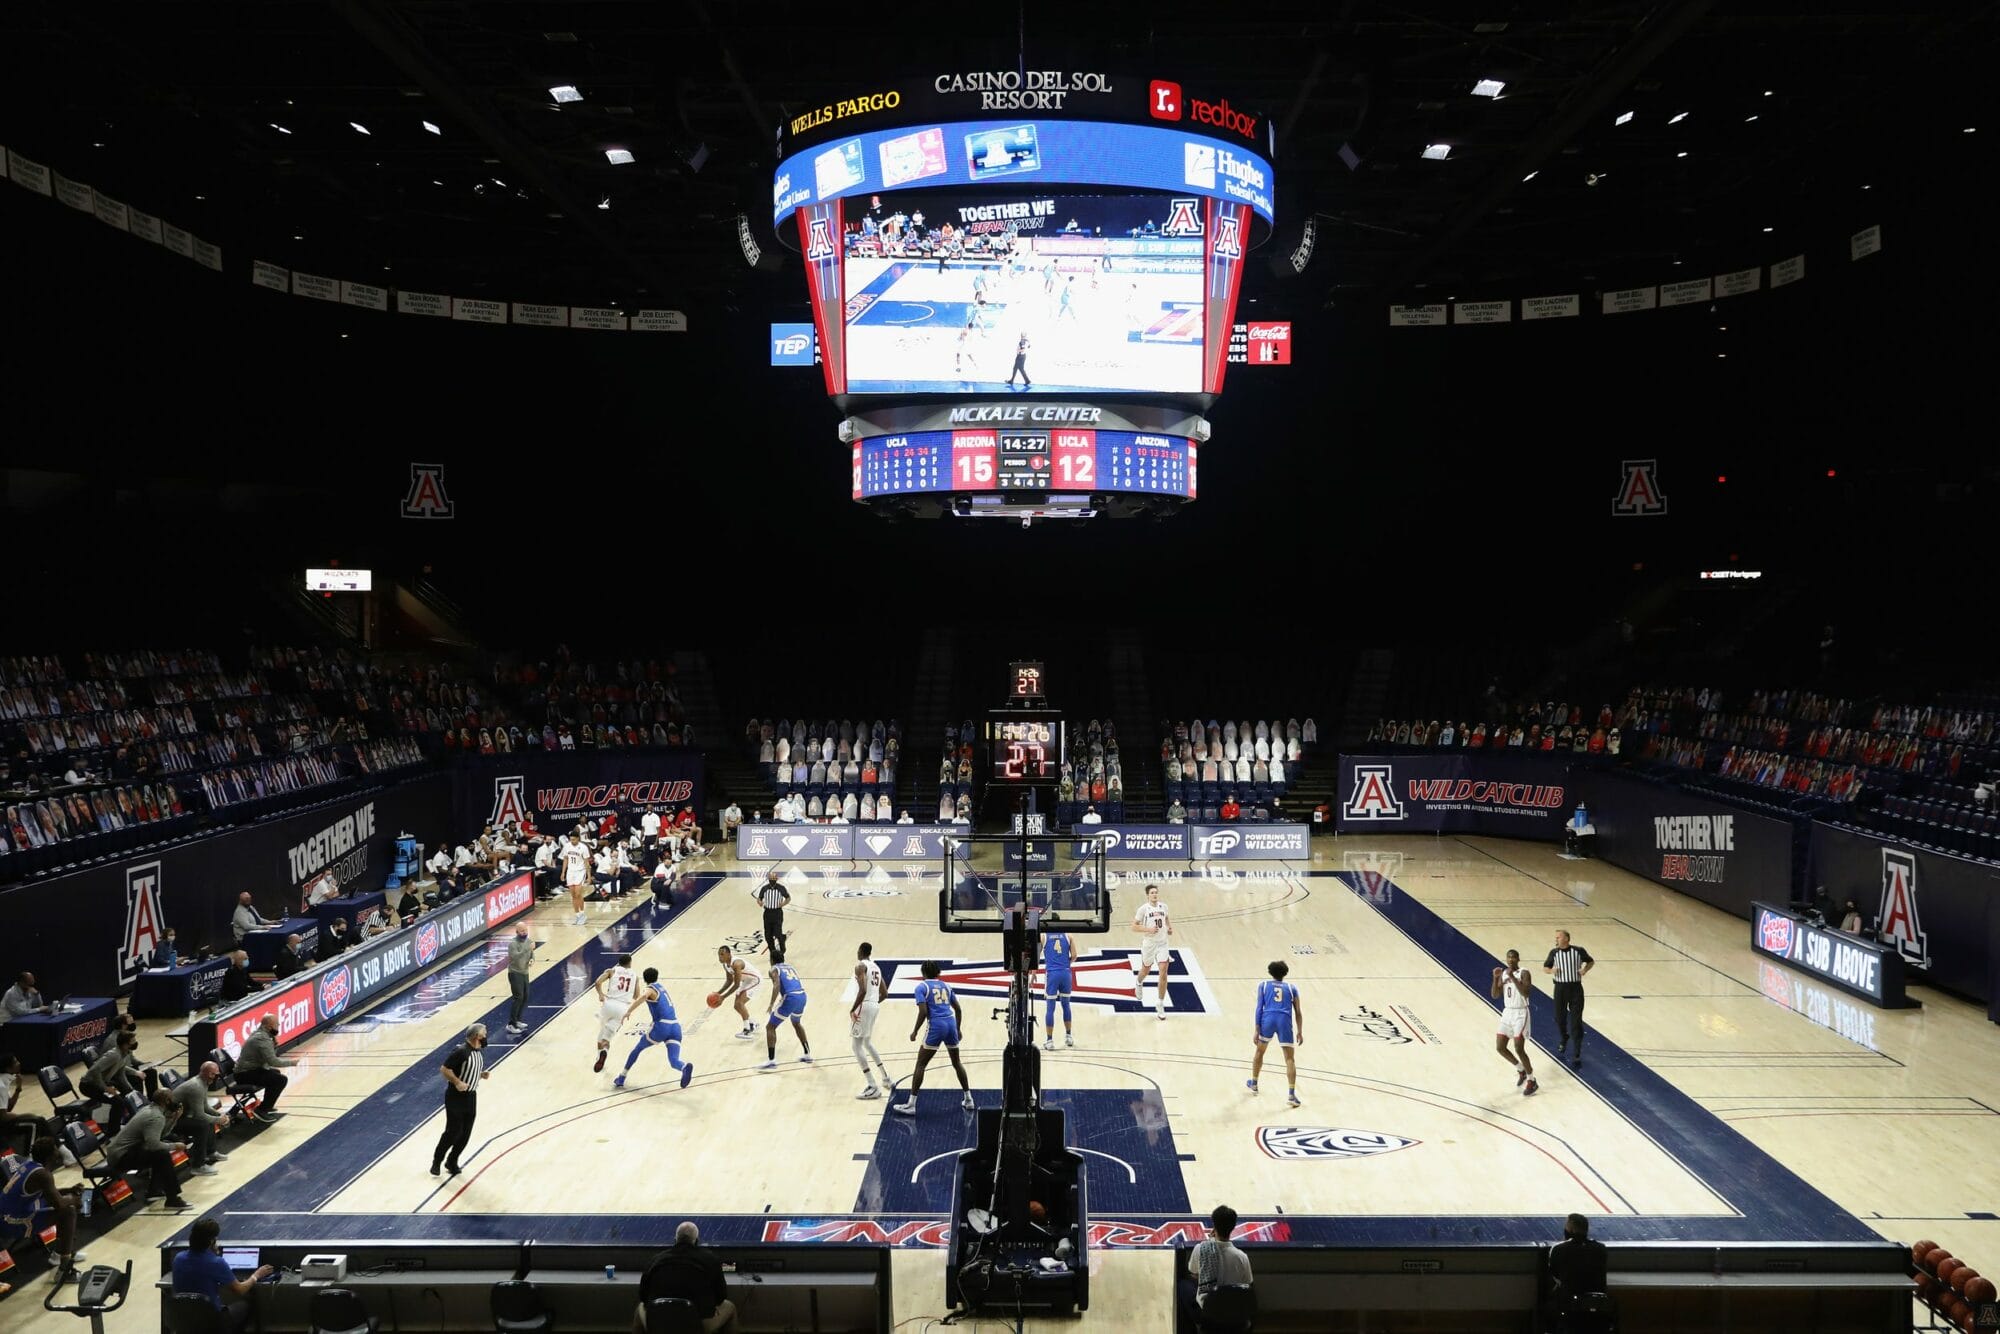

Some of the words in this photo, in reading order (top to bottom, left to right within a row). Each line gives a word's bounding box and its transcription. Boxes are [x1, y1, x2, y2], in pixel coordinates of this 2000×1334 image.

[935, 71, 1020, 93] CASINO
[1025, 71, 1069, 91] DEL
[1072, 72, 1113, 94] SOL
[982, 91, 1066, 111] RESORT
[791, 105, 833, 135] WELLS
[836, 91, 900, 120] FARGO
[1192, 98, 1256, 139] redbox
[1217, 150, 1264, 189] Hughes
[959, 202, 1032, 223] TOGETHER
[1033, 200, 1056, 215] WE
[775, 335, 809, 355] TEP
[949, 407, 1027, 422] MCKALE
[1030, 407, 1102, 422] CENTER
[886, 437, 908, 448] UCLA
[954, 436, 995, 448] ARIZONA
[1004, 438, 1046, 450] 14:27
[1058, 436, 1089, 448] UCLA
[1135, 436, 1170, 448] ARIZONA
[906, 458, 912, 467] 0
[920, 457, 926, 466] 0
[958, 455, 992, 482] 15
[1059, 455, 1093, 482] 12
[1124, 456, 1131, 466] 0
[906, 469, 912, 478] 0
[920, 468, 926, 477] 0
[1001, 479, 1008, 487] 3
[1013, 478, 1021, 487] 4
[1026, 478, 1034, 487] 4
[1038, 479, 1045, 487] 0
[1124, 478, 1131, 487] 0
[1139, 468, 1145, 477] 0
[401, 462, 454, 519] A
[906, 480, 912, 489] 0
[920, 479, 926, 488] 0
[1612, 459, 1667, 516] A
[1018, 678, 1037, 694] 27
[1006, 745, 1045, 777] 27
[1343, 765, 1403, 820] A
[1199, 832, 1240, 854] TEP
[1244, 840, 1303, 850] WILDCATS
[1654, 815, 1712, 850] TOGETHER
[1713, 815, 1735, 851] WE
[288, 814, 355, 885] TOGETHER
[355, 802, 375, 842] WE
[1125, 840, 1183, 850] WILDCATS
[1874, 847, 1927, 969] A
[440, 923, 446, 945] A
[447, 917, 462, 940] SUB
[463, 903, 485, 930] ABOVE
[1154, 918, 1163, 929] 10
[1054, 938, 1062, 954] 4
[353, 967, 360, 993] A
[362, 957, 380, 988] SUB
[383, 941, 411, 974] ABOVE
[1793, 927, 1804, 962] A
[1807, 932, 1830, 972] SUB
[1833, 945, 1878, 992] ABOVE
[617, 976, 631, 992] 31
[932, 988, 950, 1005] 24
[1273, 987, 1283, 1003] 3
[277, 997, 309, 1037] Farm
